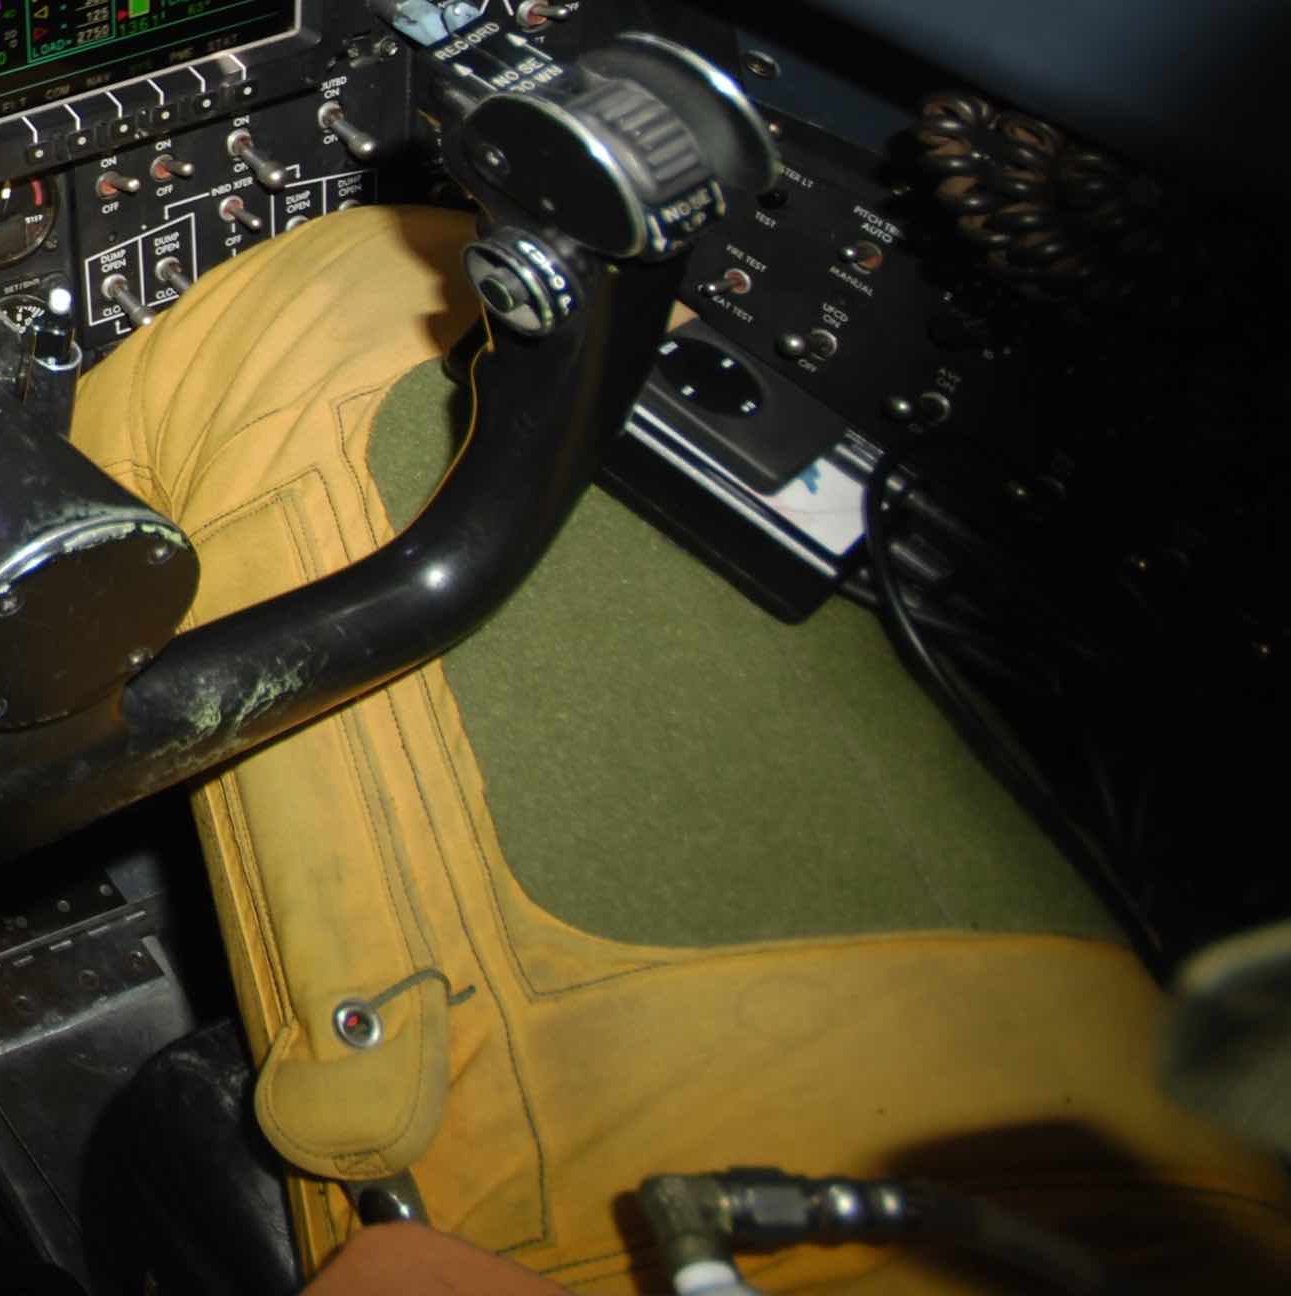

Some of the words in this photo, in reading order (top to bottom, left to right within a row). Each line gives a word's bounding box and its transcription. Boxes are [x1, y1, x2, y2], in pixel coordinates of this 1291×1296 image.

[434, 21, 501, 62] RECORD
[323, 87, 340, 100] ON
[233, 114, 250, 128] ON
[155, 139, 172, 152] ON
[100, 156, 117, 169] ON
[156, 184, 173, 198] OFF
[232, 177, 254, 192] XFER
[285, 190, 312, 206] DUMP
[286, 200, 312, 214] OPEN
[754, 210, 777, 229] TEST
[853, 204, 885, 230] PITCH
[154, 230, 180, 248] DUMP
[224, 233, 243, 247] OFF
[861, 221, 893, 245] AUTO
[154, 241, 180, 255] OPEN
[100, 251, 126, 265] DUMP
[101, 259, 126, 273] OPEN
[725, 243, 746, 263] FIRE
[743, 253, 767, 274] TEST
[829, 265, 875, 297] MANUAL
[732, 303, 754, 324] TEST
[822, 302, 849, 324] UFCD
[823, 313, 841, 329] ON
[798, 357, 817, 374] OFF
